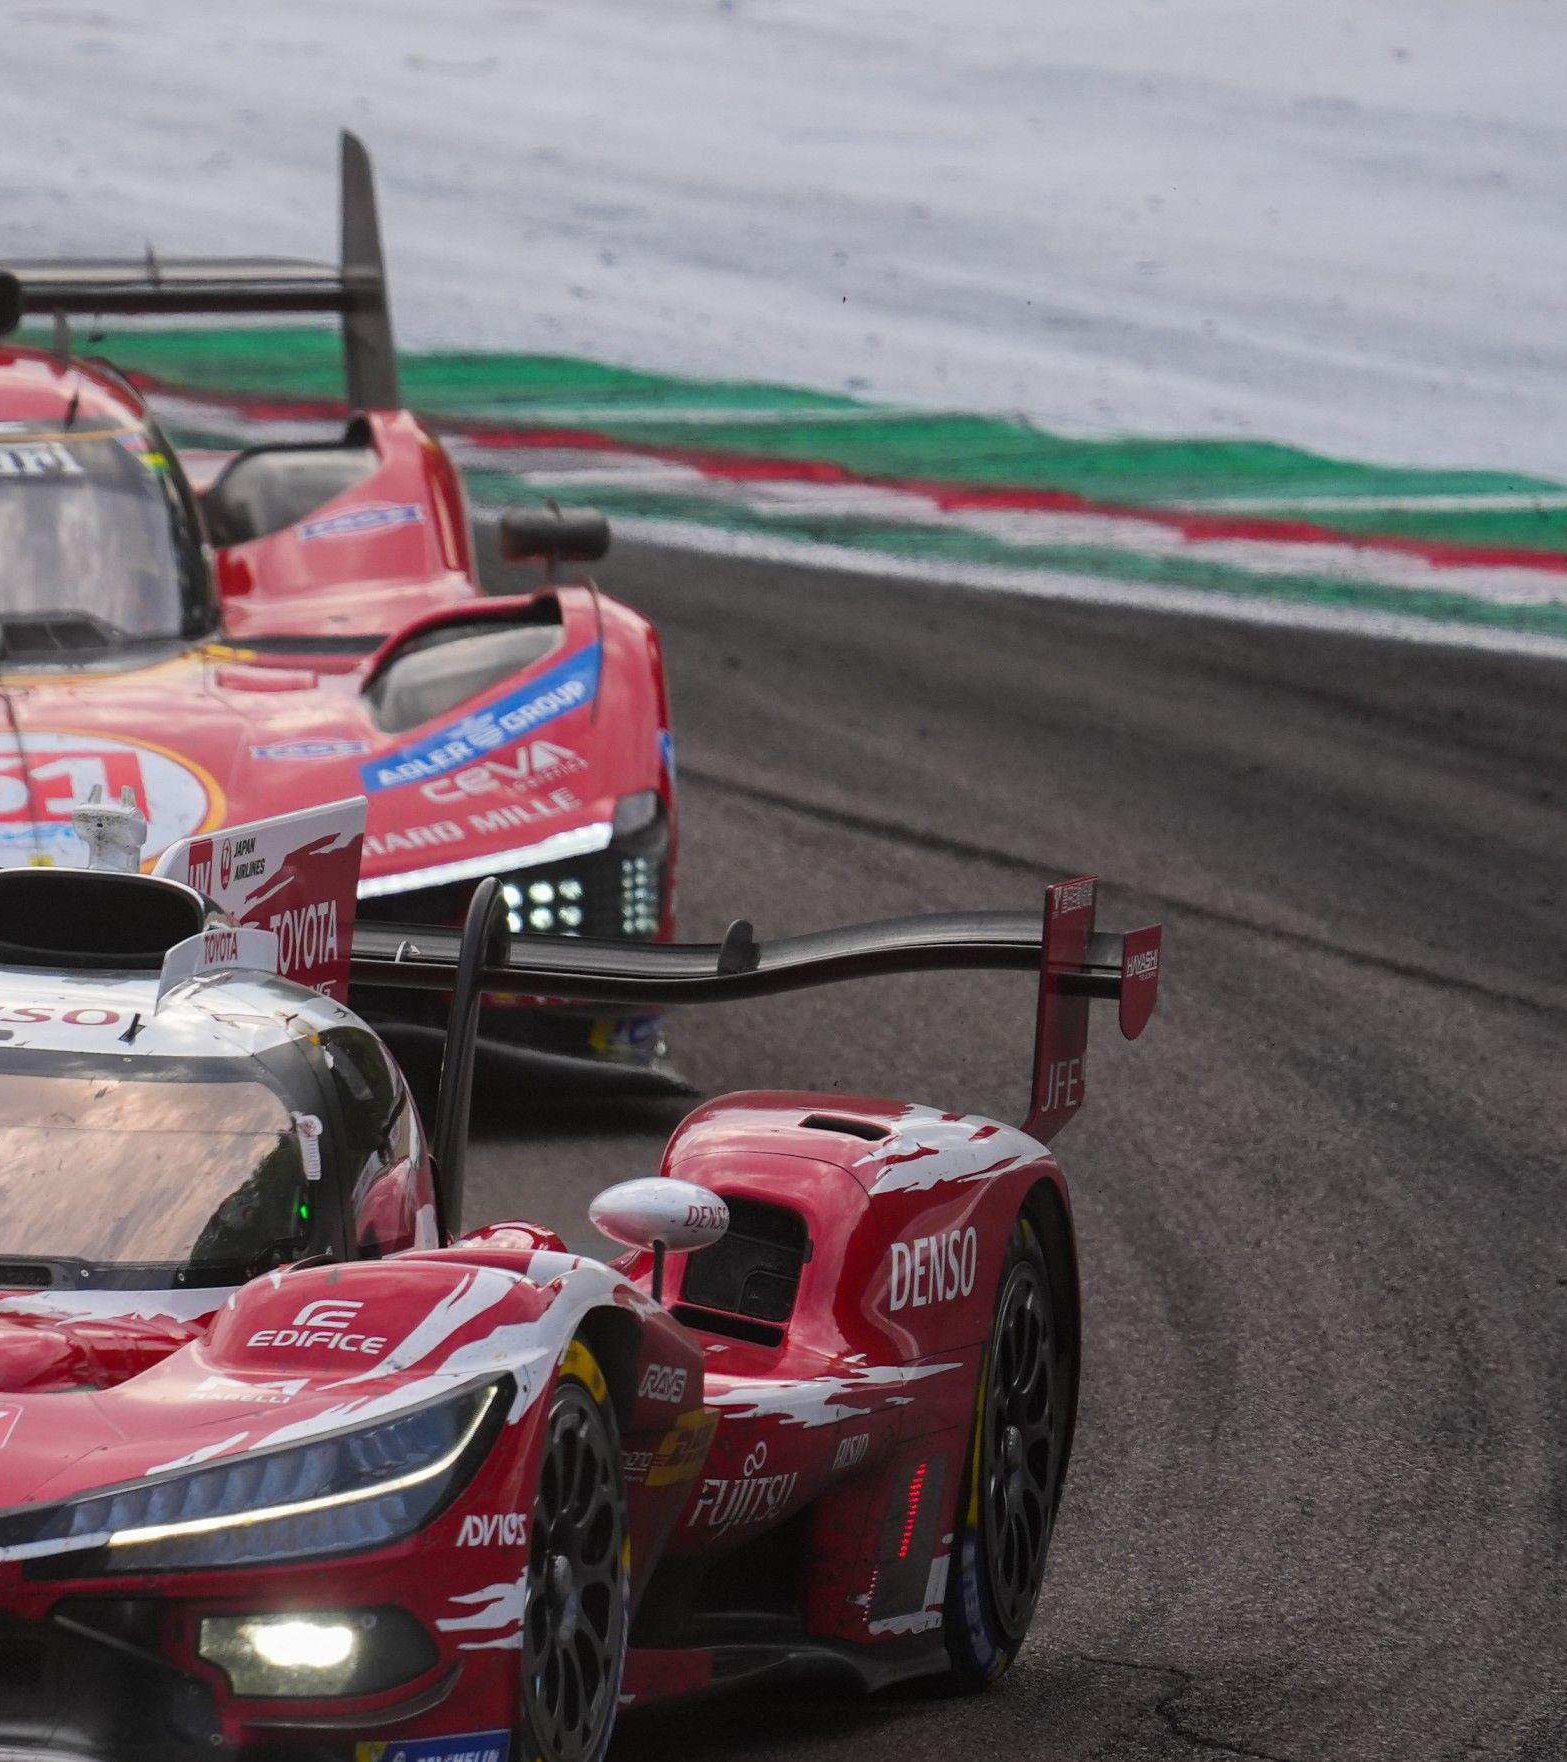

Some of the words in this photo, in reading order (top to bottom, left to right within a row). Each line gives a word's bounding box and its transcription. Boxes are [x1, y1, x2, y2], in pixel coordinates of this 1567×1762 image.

[378, 740, 473, 786] ADLER
[499, 680, 585, 731] GROUP
[467, 786, 582, 834] MILLE
[233, 836, 257, 858] JAPAN
[233, 857, 266, 882] AIRLINES
[204, 931, 238, 966] TOYOTA
[269, 899, 338, 976] TOYOTA
[1041, 1058, 1080, 1112] JFE
[890, 1225, 977, 1312] DENSO
[246, 1329, 388, 1355] EDIFICE
[637, 1363, 688, 1403] RAYS
[687, 1471, 798, 1542] FUJITSU
